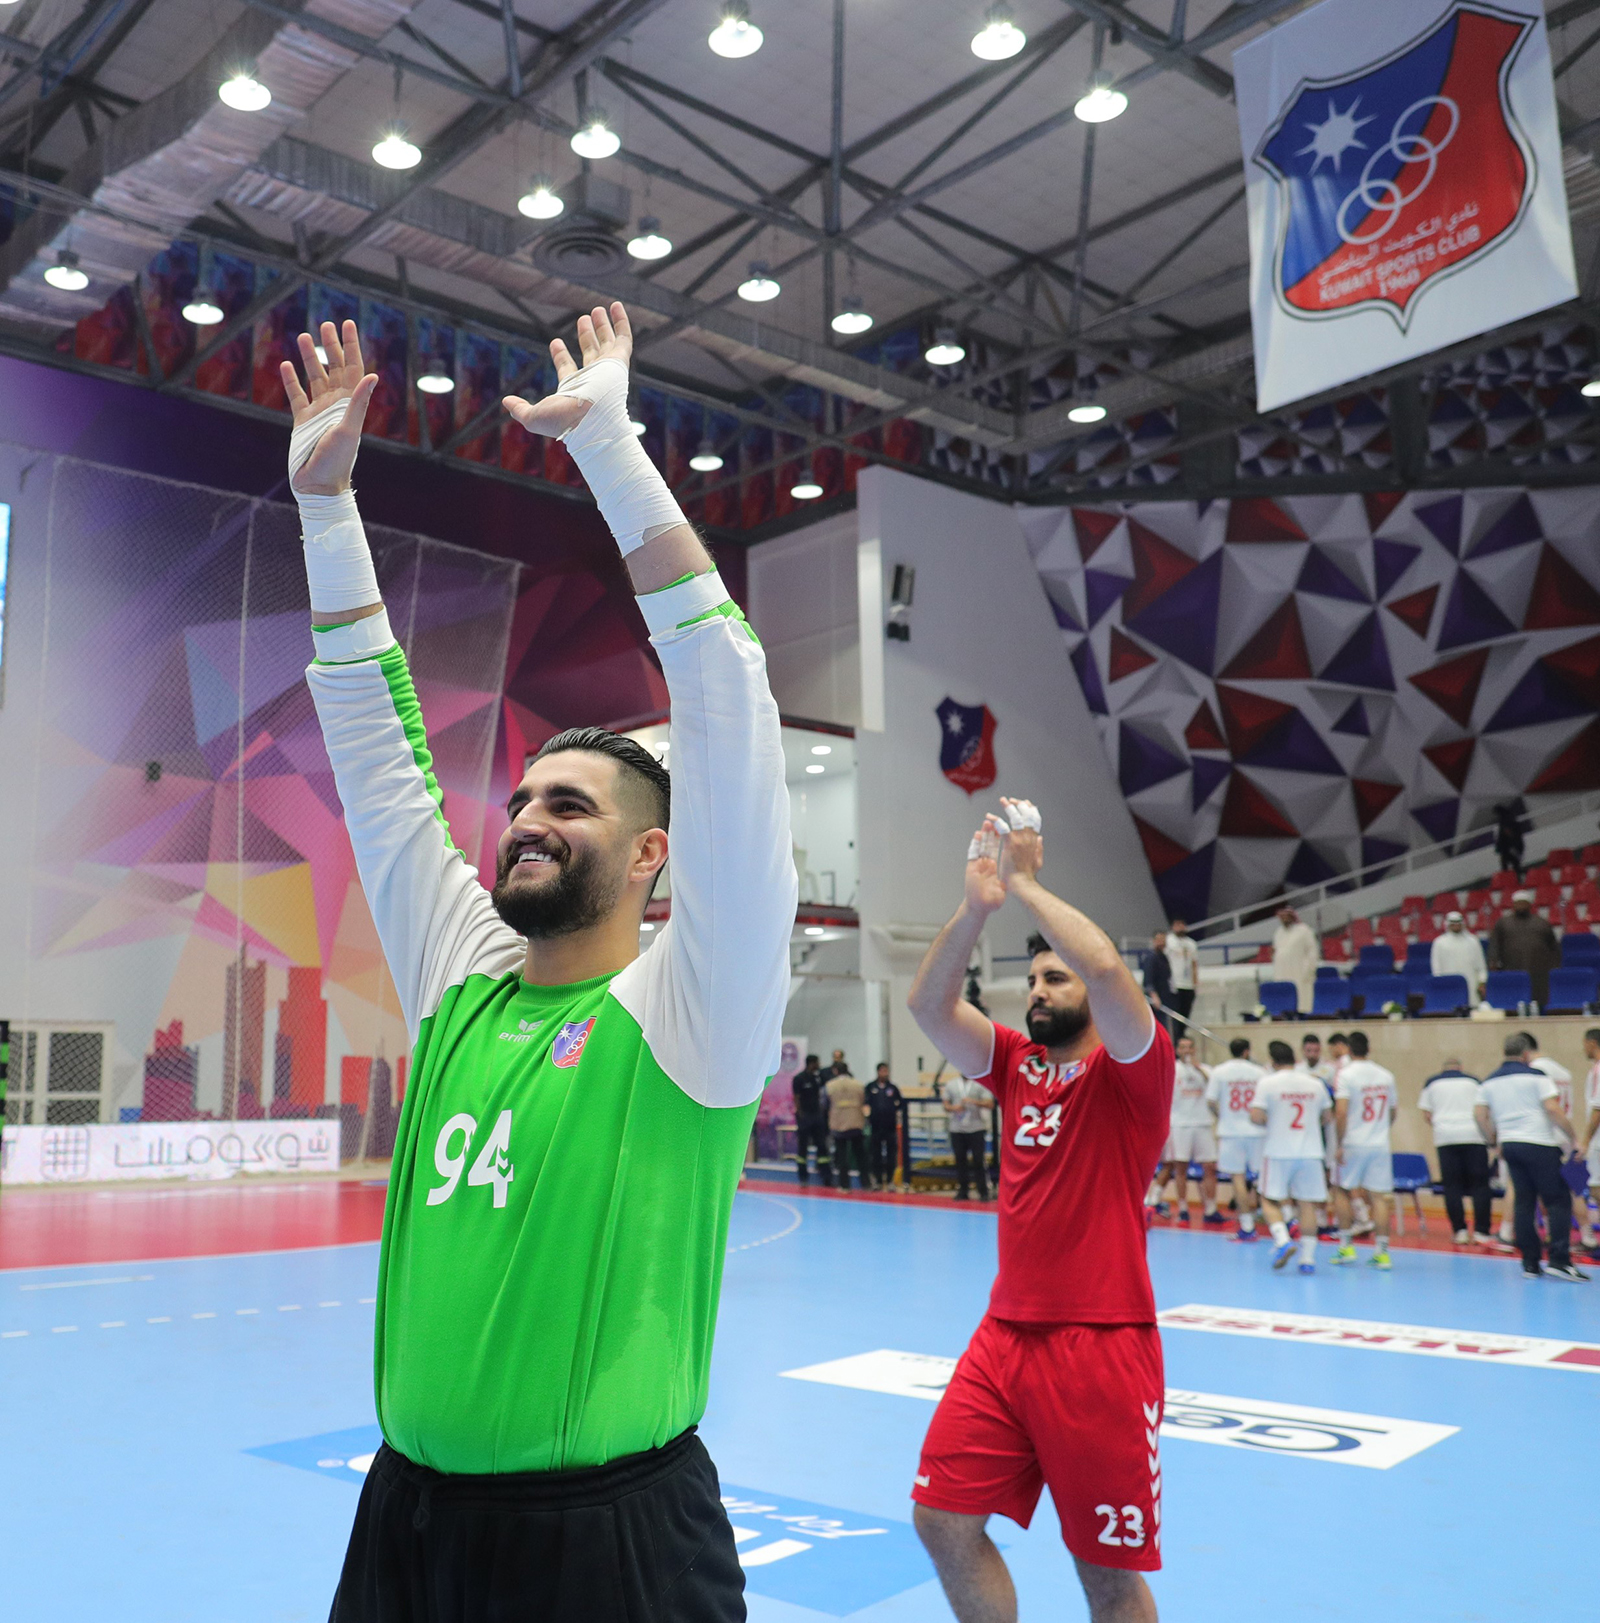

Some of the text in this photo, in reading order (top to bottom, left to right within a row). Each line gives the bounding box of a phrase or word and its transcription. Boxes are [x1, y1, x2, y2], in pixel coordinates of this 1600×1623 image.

[1445, 201, 1480, 234] نادي
[1382, 216, 1443, 253] الكويت
[1319, 224, 1481, 302] KUWAIT SPORTS CLUB
[1379, 268, 1420, 297] 1960
[498, 1031, 534, 1043] erim
[1229, 1088, 1256, 1112] 88
[1289, 1102, 1304, 1129] 2
[1361, 1094, 1388, 1122] 87
[1014, 1103, 1062, 1147] 23
[426, 1109, 514, 1209] 94
[764, 1514, 889, 1540] For
[1094, 1503, 1146, 1548] 23
